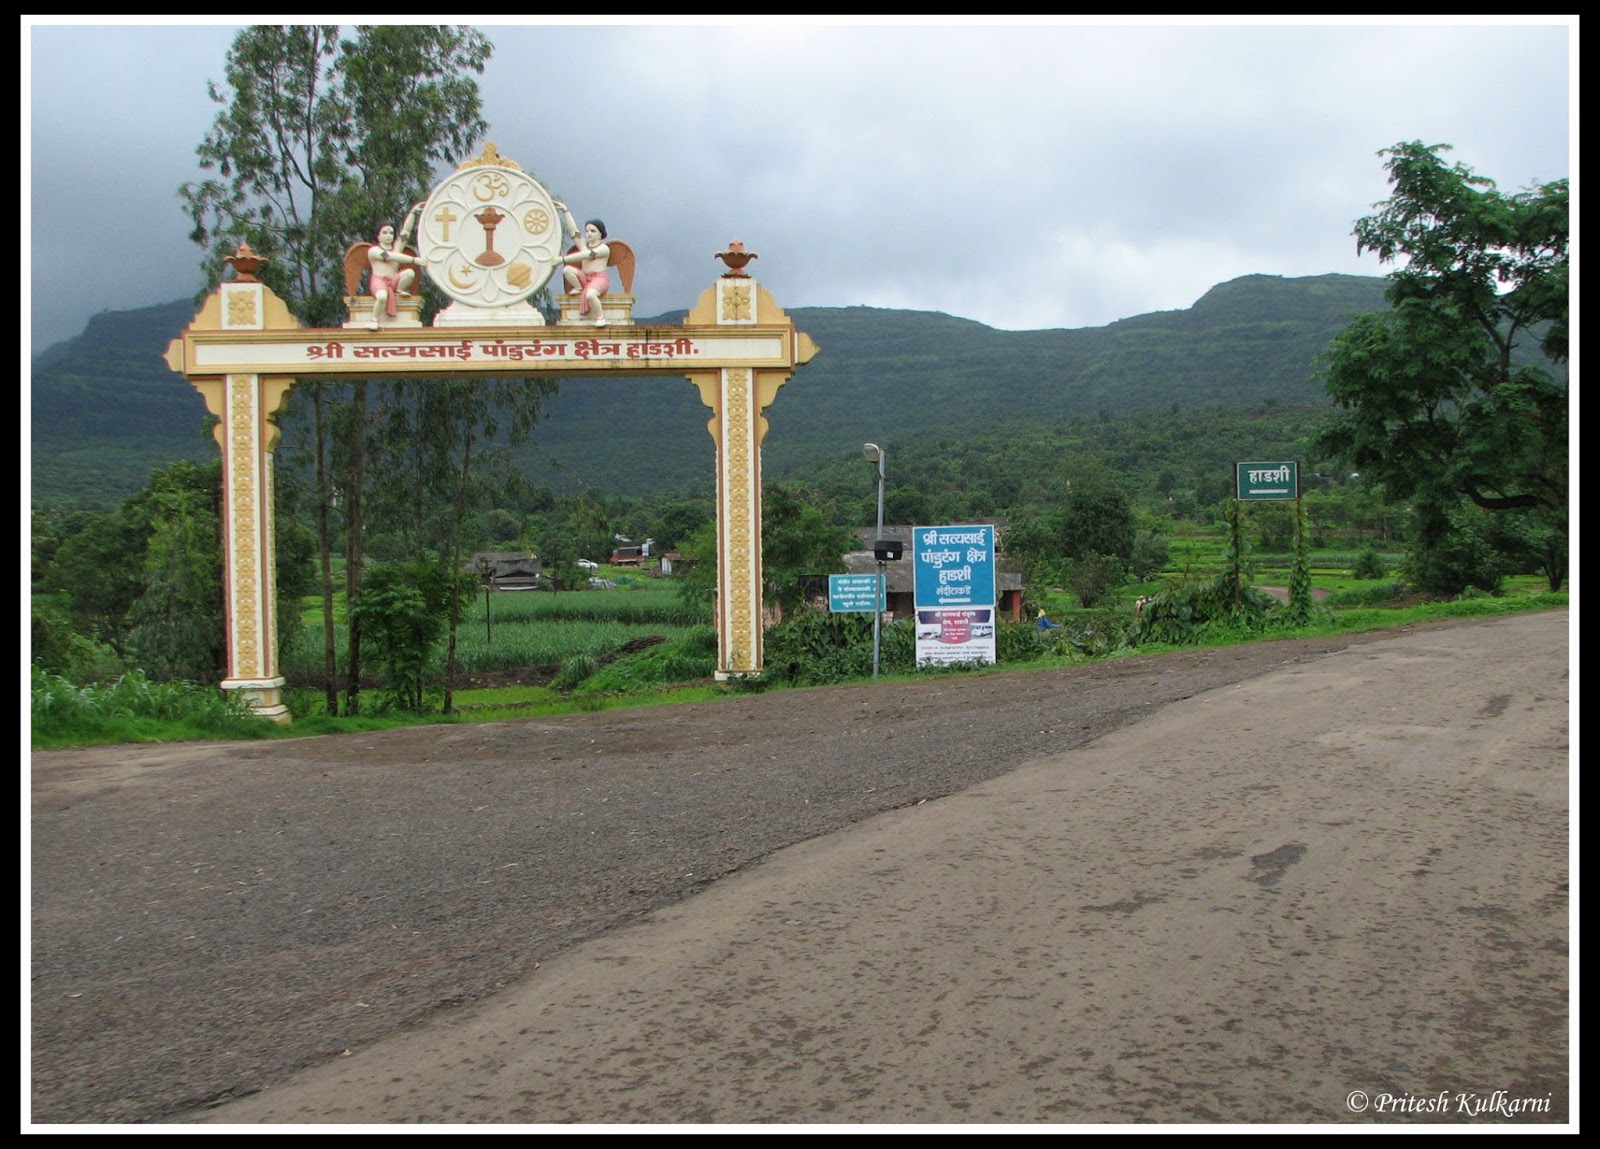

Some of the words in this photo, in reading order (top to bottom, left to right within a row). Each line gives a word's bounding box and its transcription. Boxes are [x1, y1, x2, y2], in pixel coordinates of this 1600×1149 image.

[306, 341, 344, 360] श्री
[353, 340, 473, 361] सत्यसाई
[479, 339, 568, 361] पांडुरंग
[574, 339, 622, 360] क्षेत्र
[1247, 465, 1290, 484] हाडशी
[922, 530, 938, 545] श्री
[939, 529, 987, 546] सत्यसाई
[920, 549, 961, 568] पांडुरंग
[966, 547, 987, 563] क्षेत्र
[939, 565, 972, 584] हाडशी
